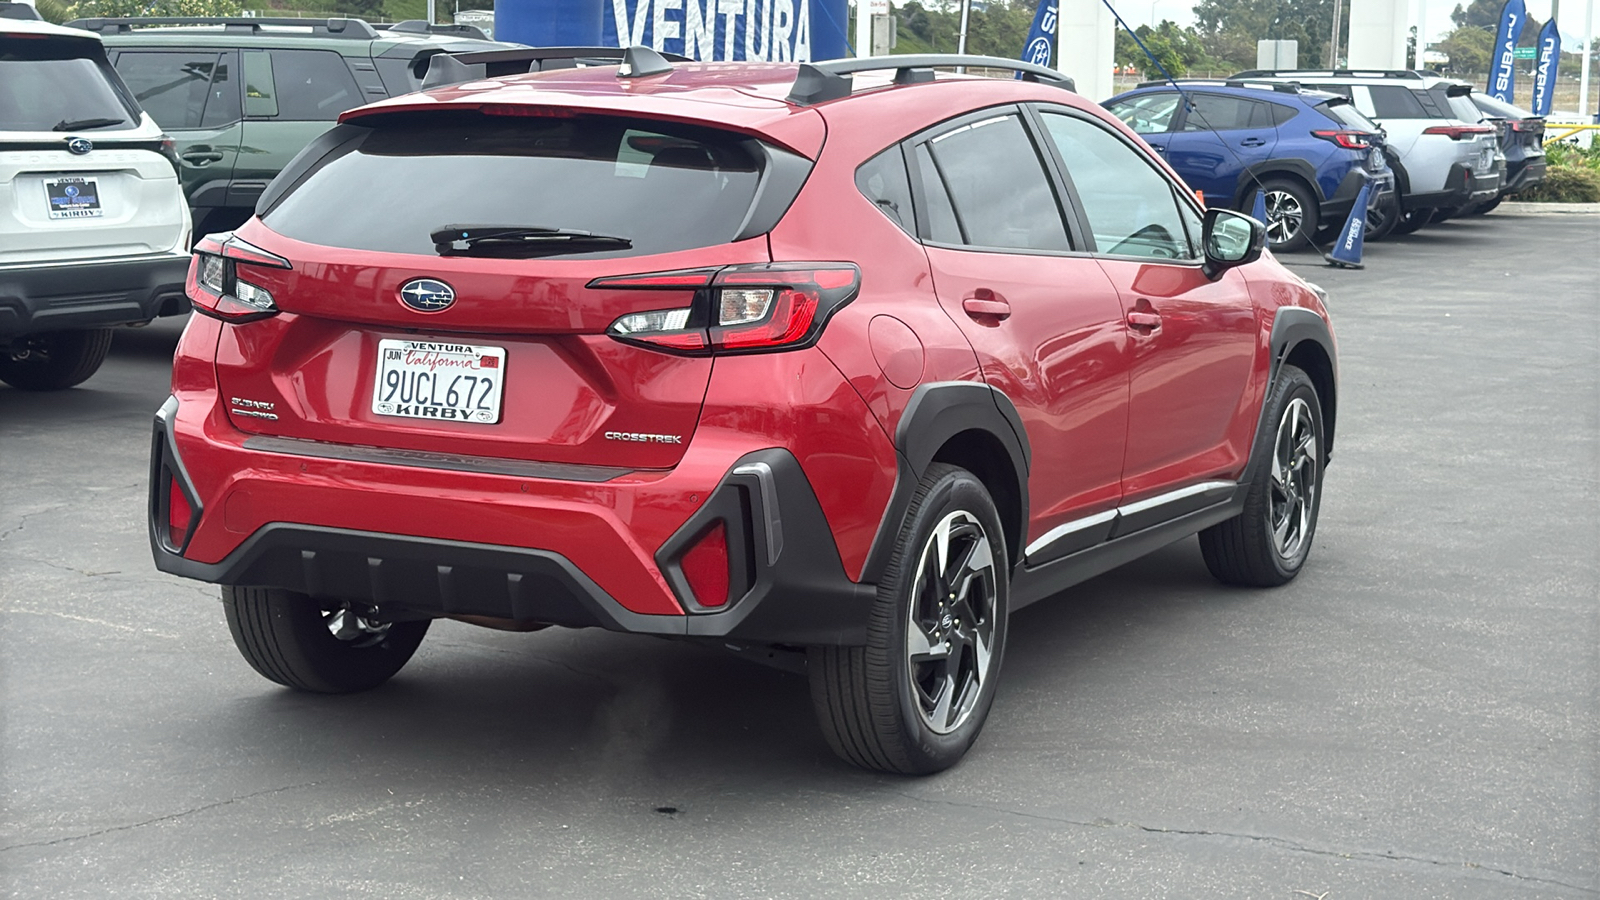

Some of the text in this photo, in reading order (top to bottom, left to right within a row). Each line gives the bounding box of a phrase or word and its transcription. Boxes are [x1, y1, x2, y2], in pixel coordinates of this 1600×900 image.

[613, 0, 811, 62] VENTURA
[411, 342, 473, 353] VENTURA
[386, 350, 402, 361] JUN
[405, 349, 481, 372] California
[383, 369, 493, 411] 9UCL672
[231, 397, 275, 409] SUBARU
[395, 404, 475, 420] KIRBY
[604, 431, 682, 443] CROSSTREK
